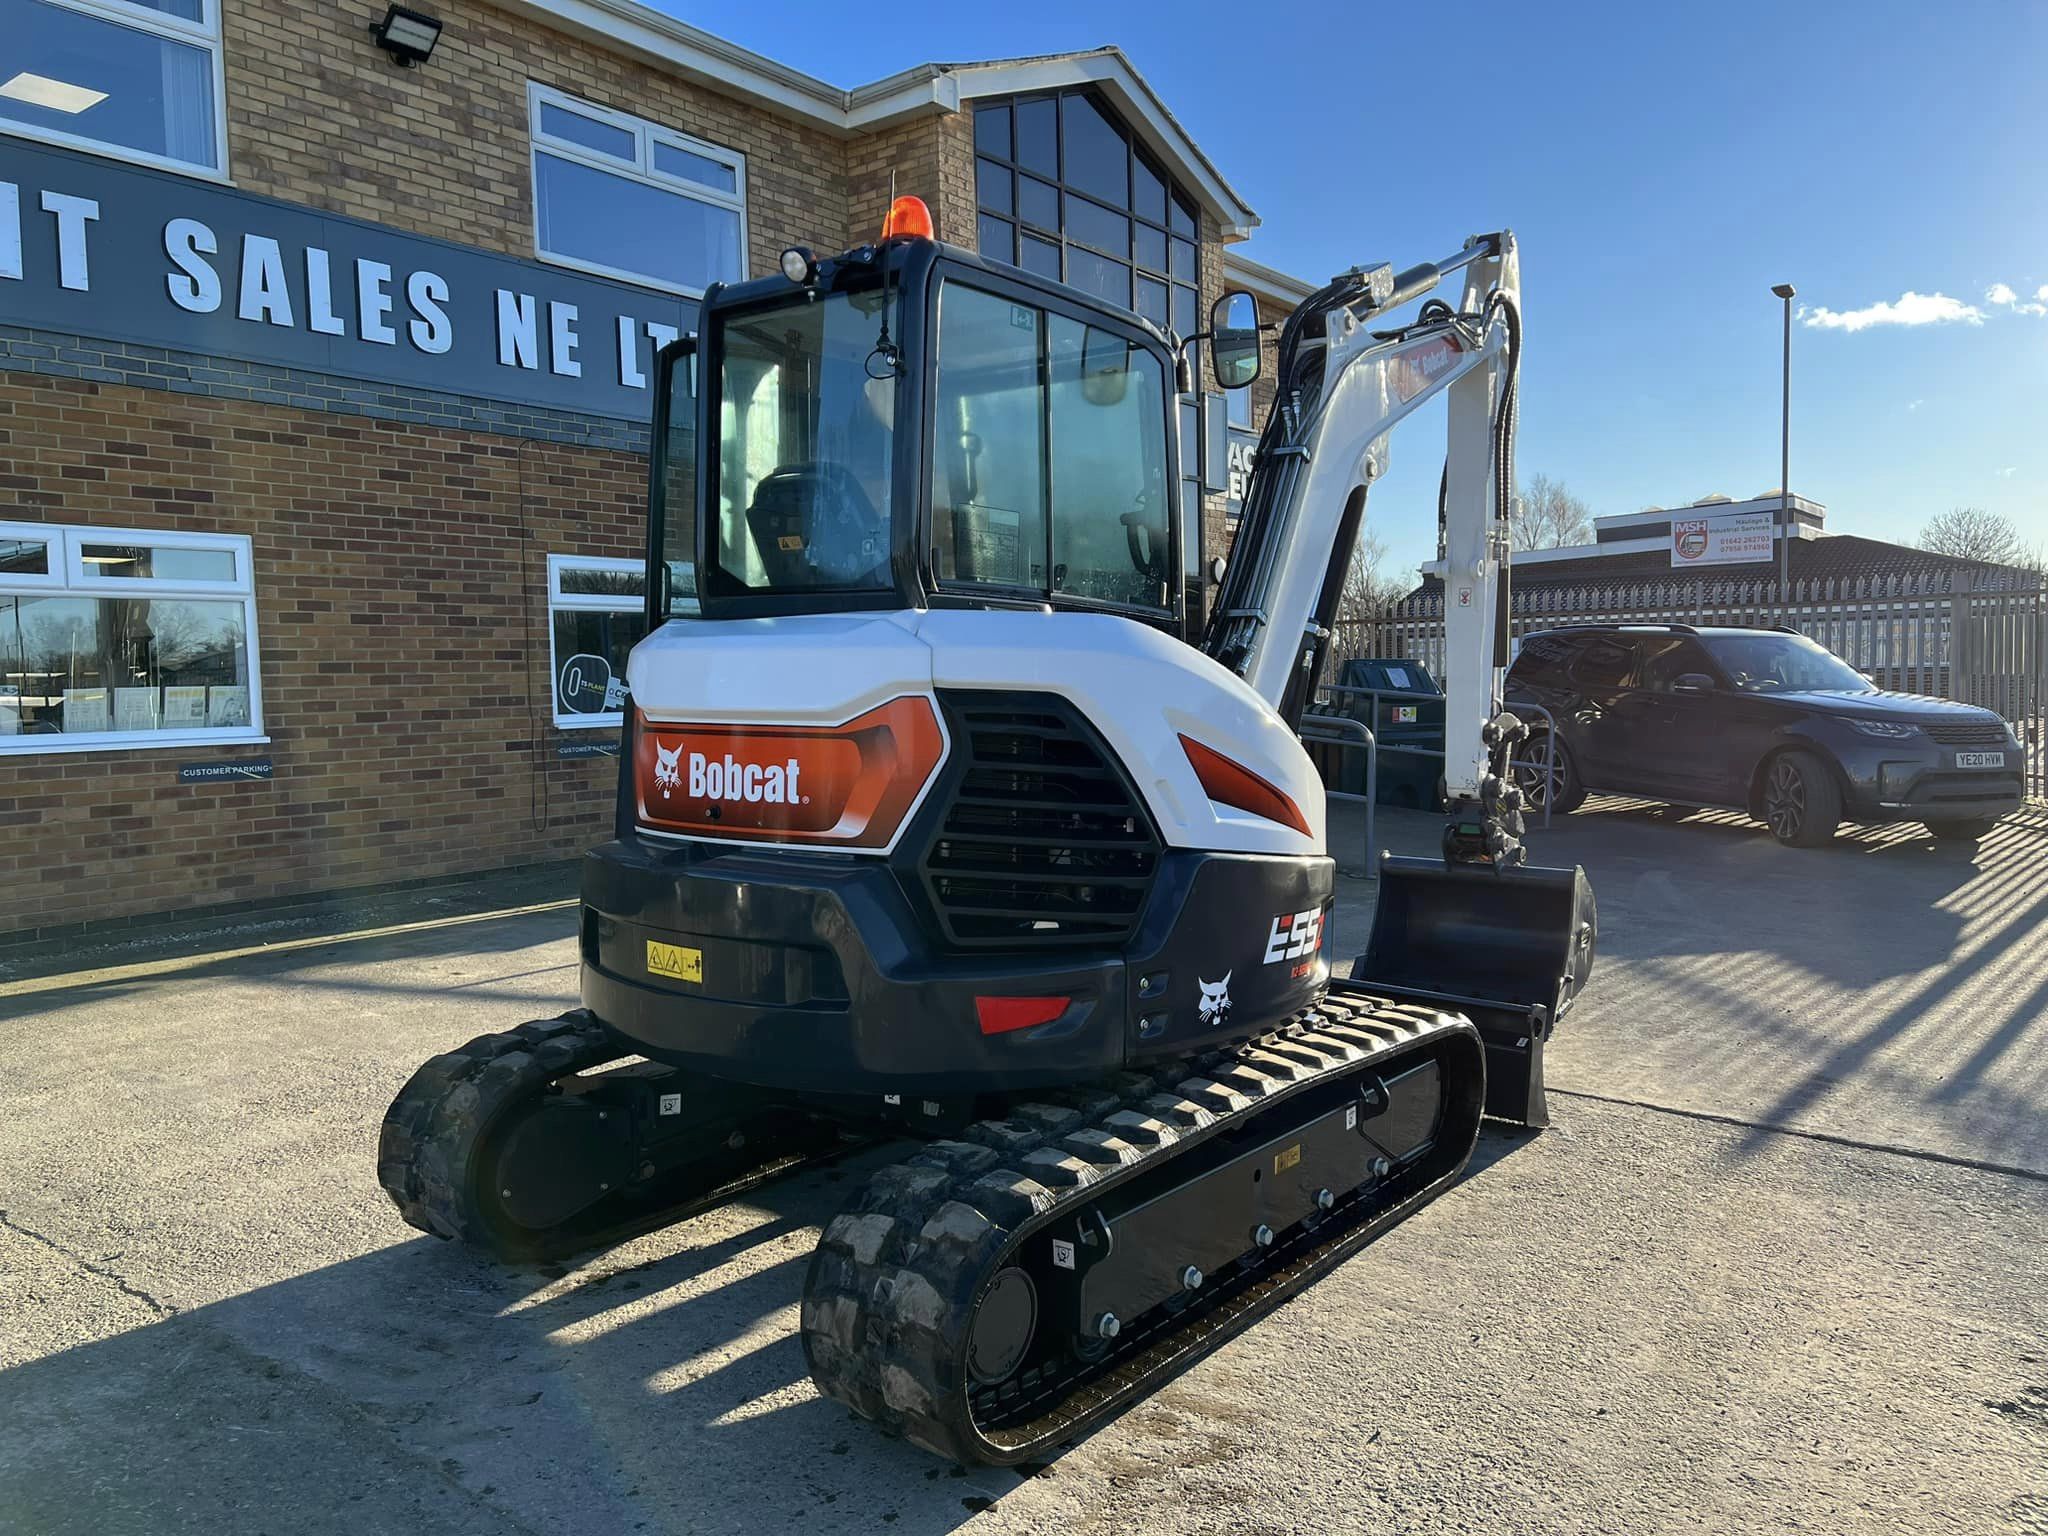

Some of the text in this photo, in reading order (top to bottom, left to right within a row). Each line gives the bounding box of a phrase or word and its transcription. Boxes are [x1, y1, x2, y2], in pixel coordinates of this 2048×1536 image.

[165, 217, 452, 355] SALES
[497, 288, 581, 378] NE
[1676, 521, 1707, 532] MSH
[1741, 524, 1770, 532] Services
[560, 744, 592, 754] CUSTOMER
[1960, 753, 1983, 765] YE20
[183, 764, 269, 777] CUSTOMER PARKING
[689, 752, 800, 805] Bobcat
